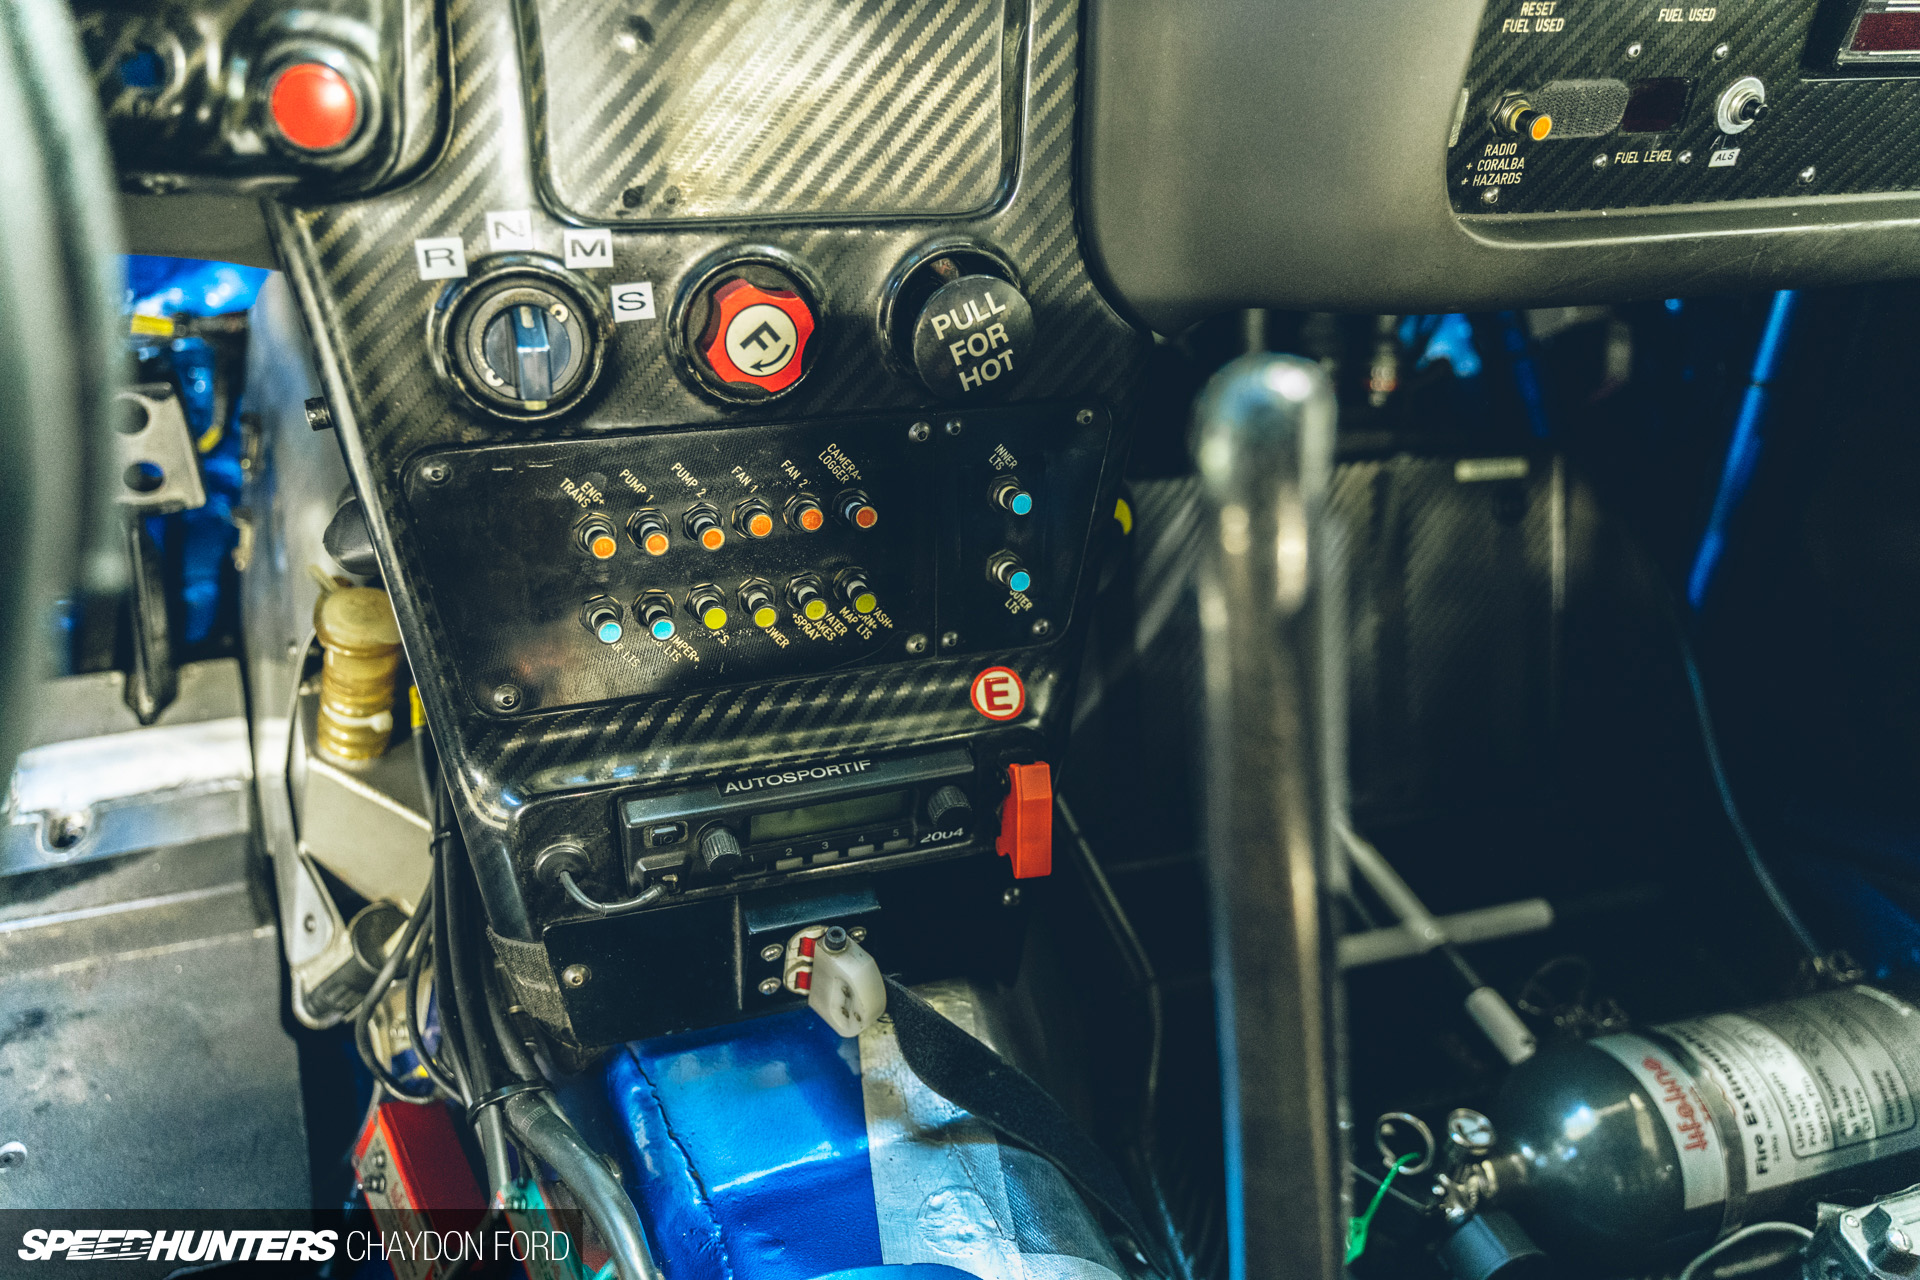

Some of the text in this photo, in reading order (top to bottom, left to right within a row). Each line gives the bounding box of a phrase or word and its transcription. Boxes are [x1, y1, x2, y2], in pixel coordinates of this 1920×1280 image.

[1520, 1, 1557, 17] RESET
[1658, 8, 1716, 22] FUEL USED
[1502, 17, 1565, 33] FUEL USED
[1484, 143, 1518, 157] RADIO
[1614, 150, 1673, 165] FUEL LEVEL
[1715, 151, 1735, 162] ALS
[1477, 157, 1525, 172] CORALBA
[1472, 172, 1522, 187] HAZARDS
[494, 219, 525, 240] N
[424, 248, 456, 268] R
[571, 239, 606, 258] M
[617, 291, 647, 311] S
[930, 291, 1007, 341] PULL
[740, 321, 781, 351] F
[949, 322, 1010, 366] FOR
[958, 349, 1014, 392] HOT
[826, 443, 862, 481] CAMERA+
[988, 454, 1005, 471] LTS
[994, 443, 1018, 469] INNER
[780, 459, 809, 489] FAN 2
[818, 450, 850, 485] LOGGER
[619, 468, 648, 495] PUMP
[671, 462, 707, 498] PUMP 2
[731, 465, 759, 494] FAN 1
[559, 478, 591, 508] TRANS
[580, 481, 605, 505] ENG+
[1004, 598, 1021, 615] LTS
[839, 606, 873, 640] MAP LTS
[873, 607, 893, 629] ASH+
[812, 620, 837, 641] AKES
[622, 651, 641, 668] LTS
[663, 645, 682, 662] LTS
[984, 676, 1013, 711] E
[723, 759, 872, 794] AUTOSPORTIF
[821, 840, 830, 851] 3
[1755, 1134, 1768, 1176] Fire
